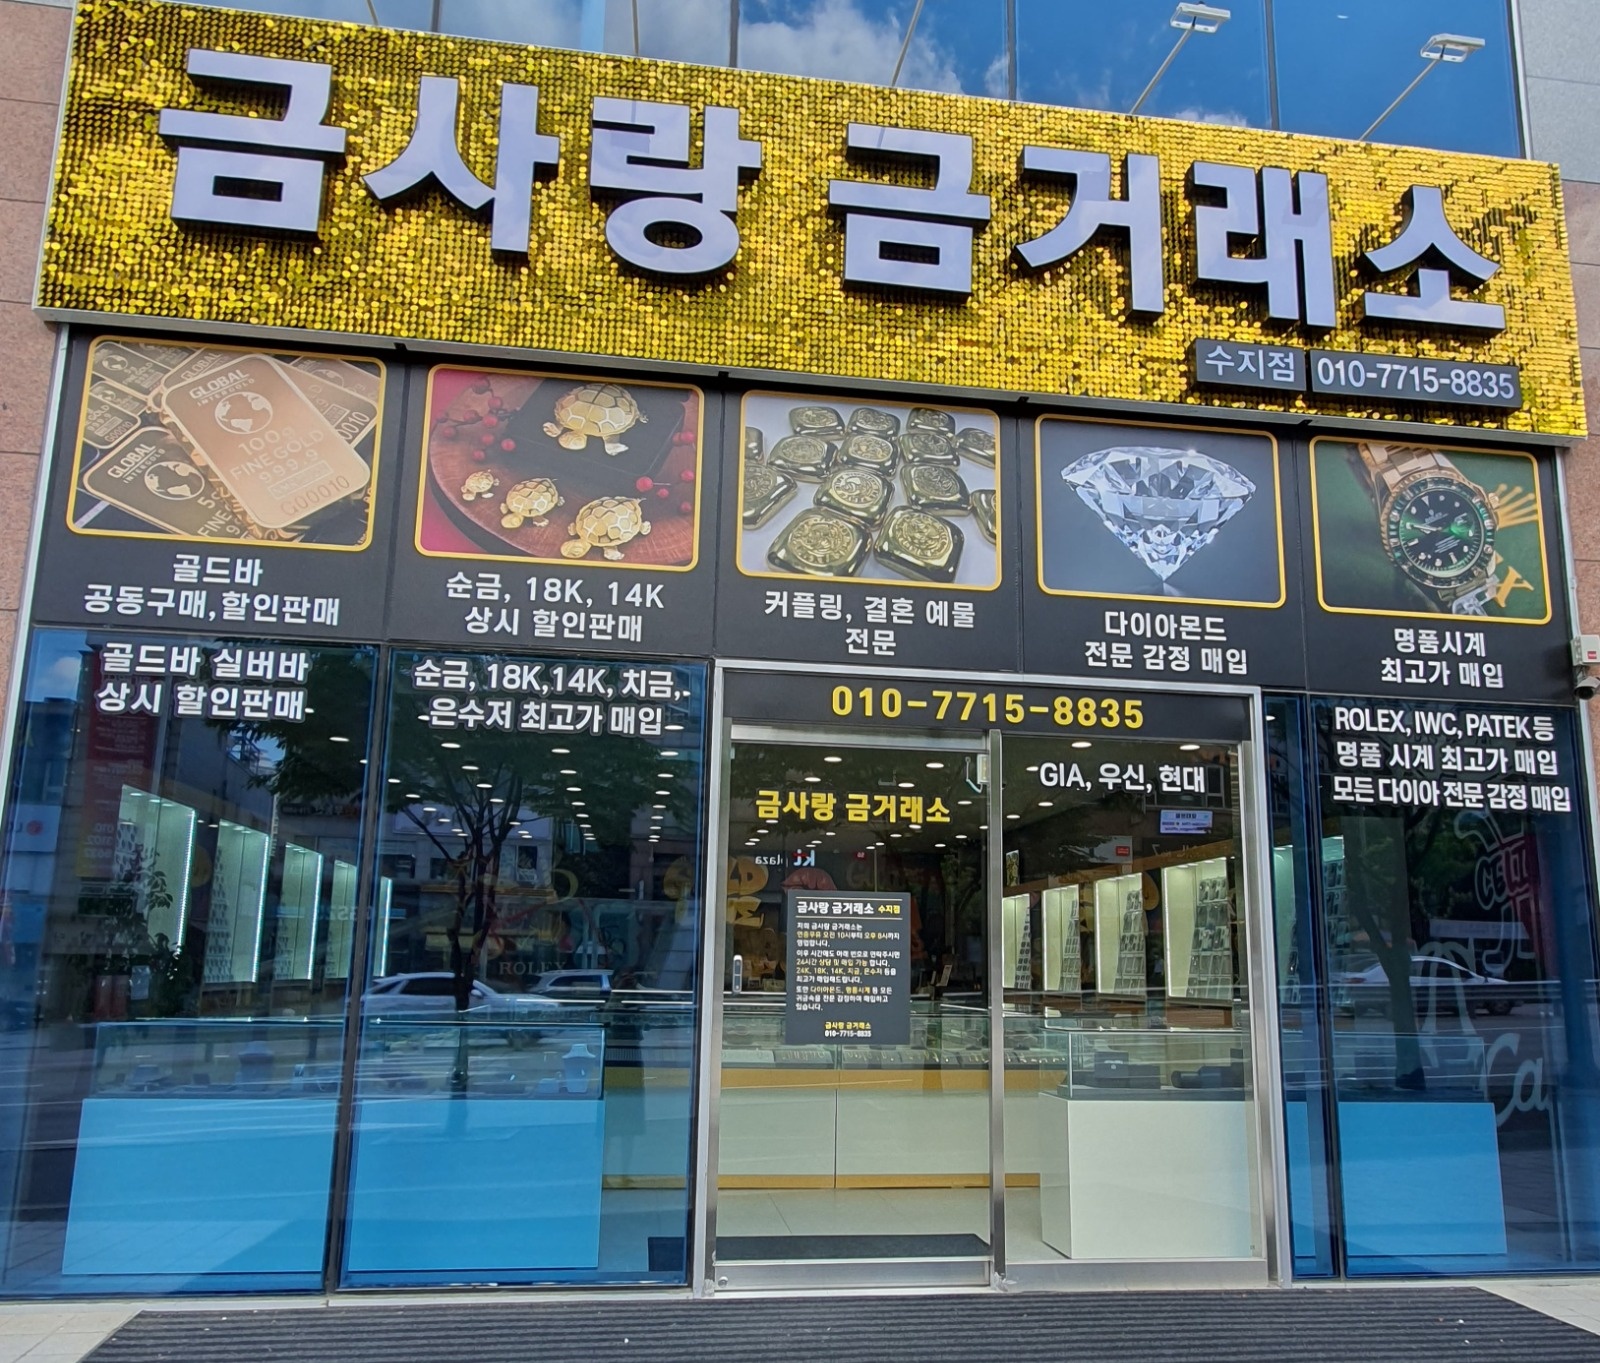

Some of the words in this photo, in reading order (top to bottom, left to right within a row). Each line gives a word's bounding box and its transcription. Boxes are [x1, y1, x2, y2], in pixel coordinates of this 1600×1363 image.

[158, 49, 761, 274] 금사랑
[828, 122, 1506, 331] 금거래소
[1205, 346, 1295, 382] 수지점
[1317, 358, 1514, 399] 010-7715-8835
[189, 370, 250, 399] GLOBAL
[107, 444, 156, 479] GLOBAL
[230, 452, 274, 481] FINE
[273, 429, 325, 457] GOLD
[173, 554, 263, 586] 골드바
[446, 572, 511, 603] 순금,
[526, 577, 593, 608] 18K,
[608, 582, 664, 609] 14K
[465, 607, 520, 636] 상시
[532, 610, 642, 642] 할인판매
[764, 591, 852, 623] 커플링,
[864, 596, 915, 626] 결혼
[926, 600, 976, 628] 예물
[1105, 611, 1227, 642] 다이아몬드
[845, 628, 896, 656] 전문
[1085, 641, 1133, 670] 전문
[1143, 644, 1191, 673] 감정
[1202, 648, 1248, 676] 매입
[1394, 628, 1486, 657] 명품시계
[103, 642, 201, 676] 골드바
[213, 649, 309, 681] 실버바
[1381, 657, 1450, 686] 최고가
[1459, 663, 1504, 689] 매입
[414, 660, 476, 692] 순금,
[621, 669, 681, 700] 치금,
[97, 682, 162, 713] 상시
[177, 685, 304, 720] 할인판매
[430, 698, 511, 729] 은수저
[521, 702, 603, 733] 최고가
[611, 707, 662, 735] 매입
[832, 686, 1143, 729] 010-7715-8835
[1335, 707, 1411, 736] ROLEX,
[1415, 711, 1462, 739] IWC,
[1337, 741, 1382, 768] 명품
[1389, 744, 1434, 771] 시계
[1442, 746, 1509, 774] 최고가
[1515, 749, 1558, 776] 매입
[1039, 763, 1091, 791] GIA,
[1098, 764, 1152, 793] 우신,
[1158, 764, 1205, 793] 현대
[1333, 776, 1375, 803] 모든
[1379, 778, 1440, 806] 다이아
[1443, 782, 1483, 808] 전문
[1487, 784, 1527, 811] 감정
[1531, 786, 1570, 813] 매입
[756, 790, 836, 822] 금사랑
[846, 794, 951, 824] 금거래소
[797, 902, 829, 914] 금사랑
[832, 902, 874, 915] 금거래소
[878, 905, 900, 914] 수지점
[824, 1030, 872, 1038] 010-7715-8835
[825, 1021, 845, 1030] 금사랑
[846, 1022, 871, 1030] 금거래소
